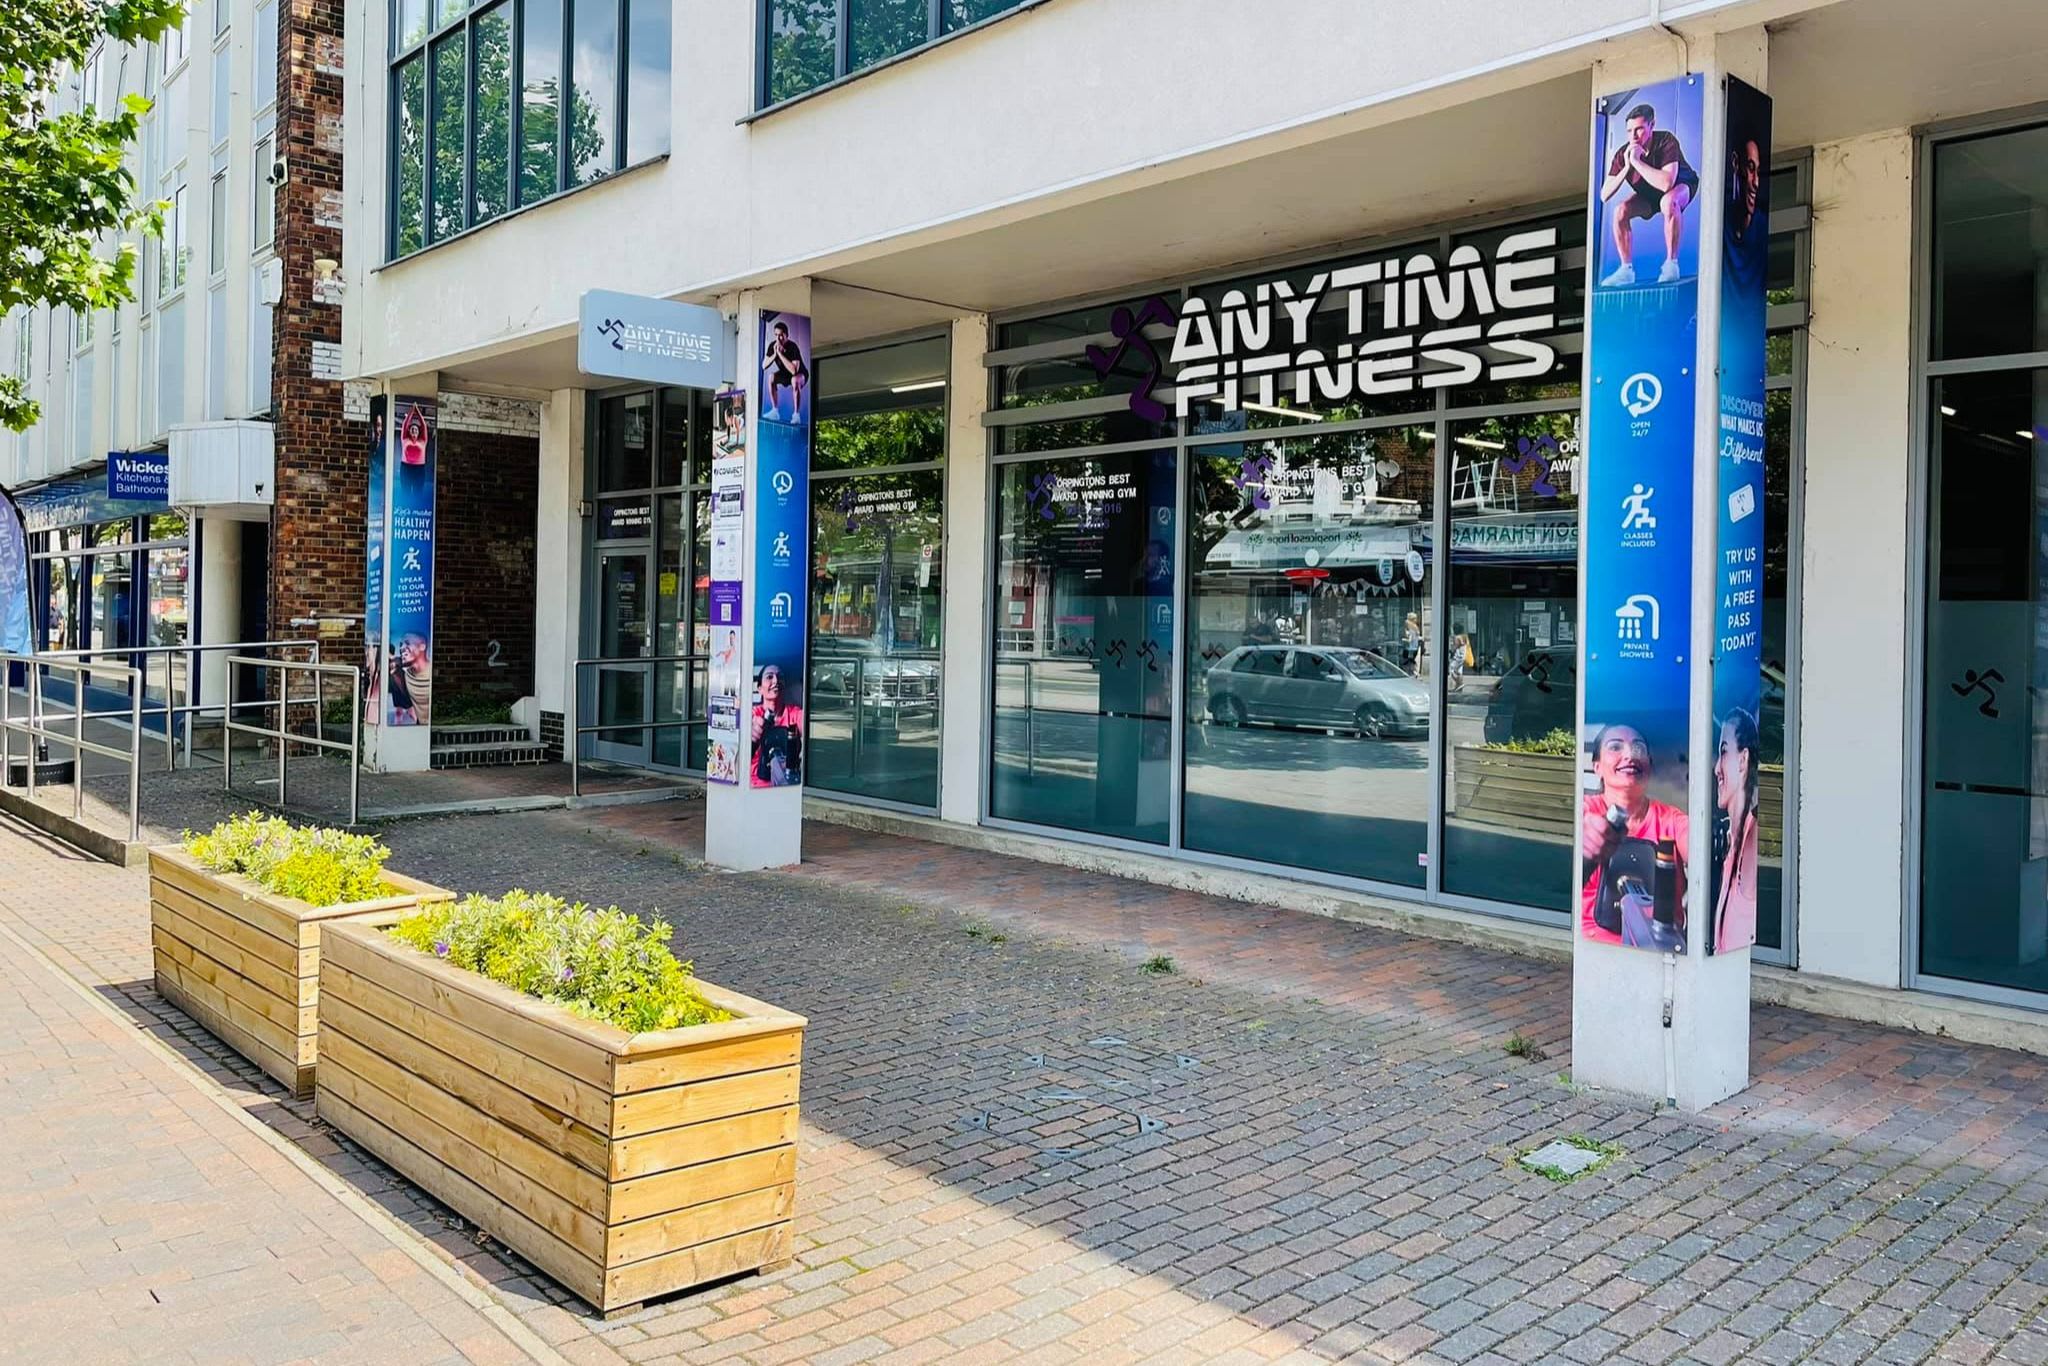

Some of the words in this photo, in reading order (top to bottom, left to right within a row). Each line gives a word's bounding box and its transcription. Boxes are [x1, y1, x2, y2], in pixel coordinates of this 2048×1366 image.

[1170, 228, 1556, 363] ANYTIME
[624, 324, 711, 350] ANYTIME
[624, 339, 711, 362] FITNESS
[1176, 313, 1555, 417] FITNESS
[1721, 394, 1763, 418] DISCOVER
[1630, 421, 1650, 429] OPEN
[1721, 413, 1737, 431] WHAT
[1737, 417, 1755, 435] MAKES
[1755, 422, 1763, 437] US
[1632, 429, 1649, 437] 24/7
[1720, 435, 1763, 465] Different
[116, 459, 168, 474] Wickes
[1342, 465, 1370, 477] BEST
[116, 472, 161, 483] Kitchens
[1056, 474, 1106, 488] ORPINGTONS
[1109, 474, 1130, 484] BEST
[896, 489, 912, 498] BEST
[1051, 491, 1078, 502] AWARD
[1081, 488, 1114, 501] WINNING
[1117, 487, 1136, 498] GYM
[394, 516, 431, 528] HEALTHY
[394, 528, 431, 541] HAPPEN
[1623, 532, 1653, 540] CLASSES
[1620, 540, 1656, 548] INCLUDED
[1725, 550, 1742, 564] TRY
[1744, 547, 1756, 562] US
[1728, 569, 1752, 586] WITH
[1724, 594, 1731, 609] A
[1732, 590, 1756, 607] FREE
[1728, 612, 1751, 629] PASS
[1623, 643, 1650, 651] PRIVATE
[1721, 632, 1756, 653] TODAY!
[488, 640, 509, 667] 2
[1619, 651, 1655, 659] SHOWERS
